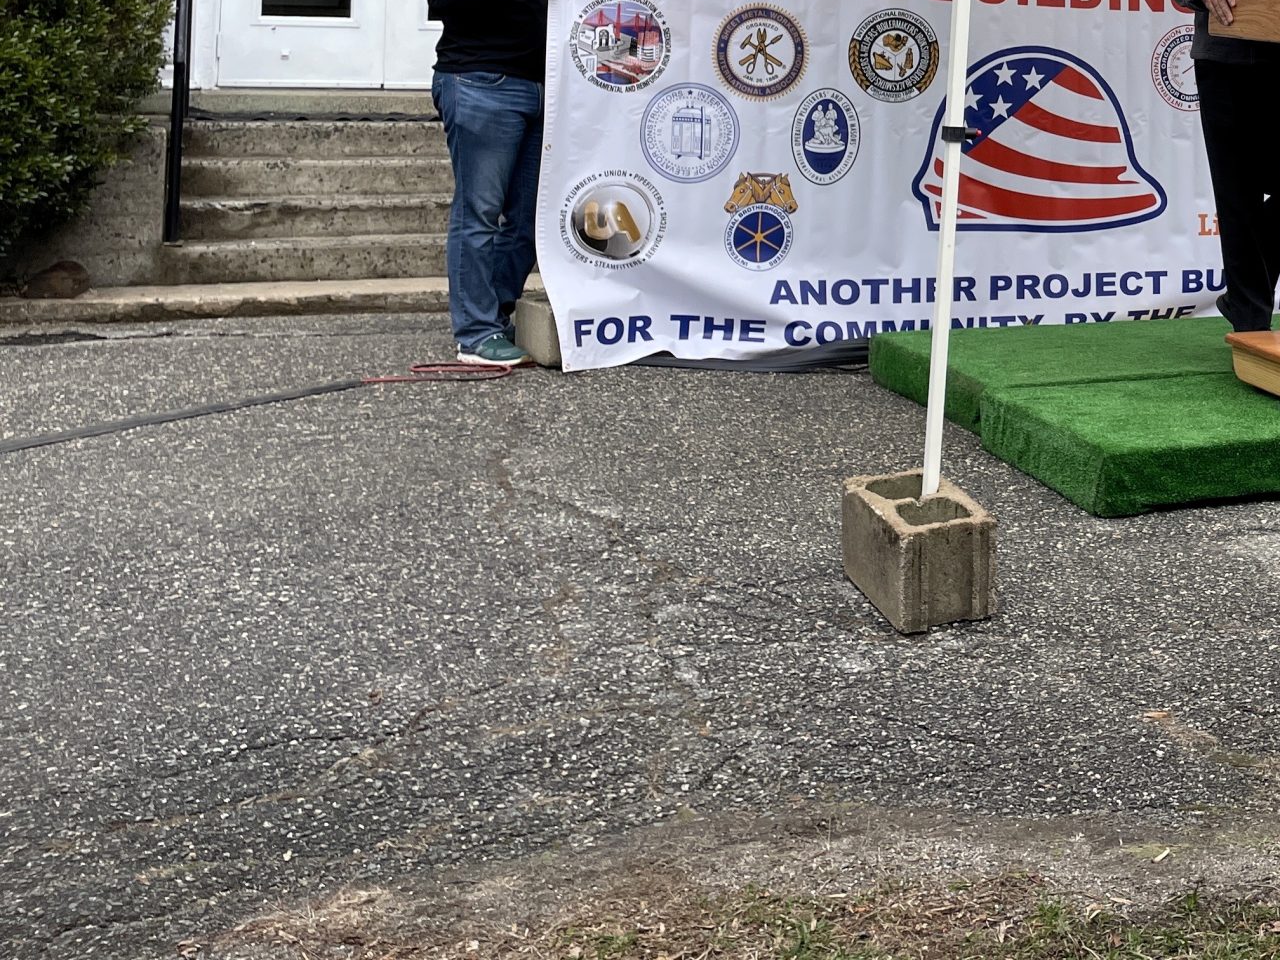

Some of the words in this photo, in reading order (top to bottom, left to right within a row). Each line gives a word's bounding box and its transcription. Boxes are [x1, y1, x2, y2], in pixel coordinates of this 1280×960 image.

[655, 11, 665, 20] OF
[721, 16, 741, 40] SHEET
[741, 10, 768, 20] METAL
[745, 22, 779, 32] ORGANIZED
[856, 10, 897, 39] INTERNATIONAL
[898, 11, 934, 41] BROTHERHOOD
[1160, 28, 1182, 48] UNION
[1161, 35, 1190, 70] ORGANIZED
[587, 74, 623, 94] ORNAMENTAL
[624, 84, 636, 94] AND
[718, 51, 765, 95] INTERNATIONAL
[765, 54, 803, 95] ASSOCIATION
[1153, 52, 1184, 108] INTERNATIONAL
[1162, 75, 1180, 98] LABOR
[646, 90, 684, 150] CONSTRUCTORS
[697, 91, 733, 146] INTERNATIONAL
[830, 92, 844, 103] AND
[841, 101, 857, 122] CEMENT
[603, 169, 628, 178] UNION
[651, 150, 691, 177] ELEVATOR
[693, 168, 706, 176] OF
[706, 148, 729, 170] UNION
[796, 150, 826, 182] INTERNATIONAL
[828, 151, 854, 182] ASSOCIATION
[565, 174, 598, 203] PLUMBERS
[633, 173, 664, 206] PIPEFITTERS
[659, 211, 667, 233] TECHS
[738, 204, 786, 221] BROTHERHOOD
[783, 220, 791, 230] OF
[645, 233, 664, 259] SERVICE
[726, 217, 749, 267] INTERNATIONAL
[768, 230, 792, 267] TEAMSTERS
[594, 259, 643, 271] STEAMFITTERS
[990, 270, 1168, 301] PROJECT
[574, 315, 654, 347] FOR
[670, 314, 767, 343] THE
